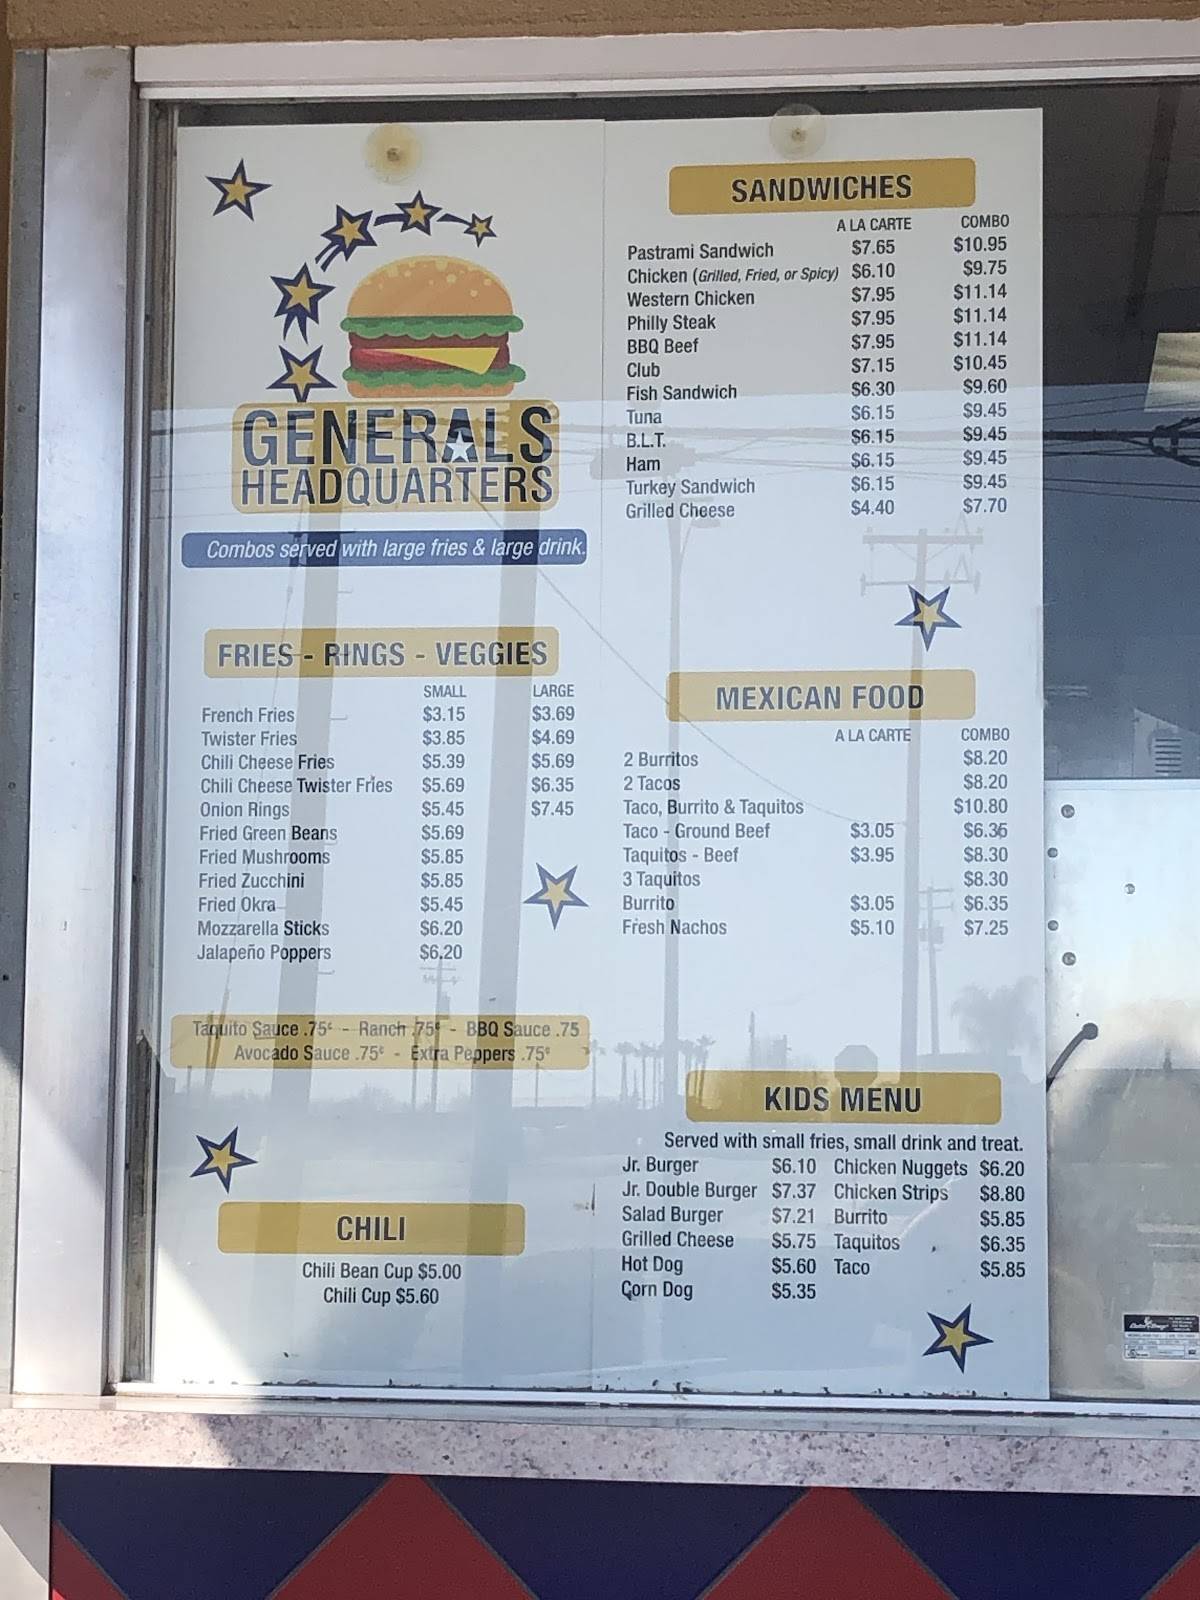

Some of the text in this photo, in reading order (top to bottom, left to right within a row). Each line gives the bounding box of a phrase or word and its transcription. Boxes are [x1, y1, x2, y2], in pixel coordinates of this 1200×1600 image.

[732, 174, 912, 203] SANDWICHES
[836, 214, 1010, 231] A LA CARTE COMBO
[627, 236, 1007, 260] Pastrami Sandwich $7.65 $10.95
[627, 260, 1007, 284] Chicken (Grilled, Fried, or Spicy) $6.10 $9.75
[627, 284, 1007, 307] Western Chicken $7.95 $11.14
[627, 355, 1007, 378] Club $7.15 $10.45
[627, 379, 1007, 401] Fish Sandwich $6.30 $9.60
[243, 405, 553, 466] GENERALS
[627, 426, 1007, 448] B.L.T. $6.15 $9.45
[241, 466, 553, 506] HEADQUARTERS
[626, 498, 1007, 519] Grilled Cheese $4.40 $7.70
[207, 537, 587, 560] Combos served with large fries & large drink.
[218, 643, 294, 668] FRIES
[324, 642, 405, 666] RINGS
[436, 641, 548, 665] VEGGIES
[424, 684, 575, 698] SMALL LARGE
[716, 685, 925, 710] MEXICAN FOOD
[202, 706, 575, 723] French Fries $3.15 $3.69
[835, 727, 1010, 742] A LA CARTE COMBO
[201, 753, 575, 771] Chili Cheese Fries $5.39 $5.69
[623, 749, 1008, 768] 2 Burritos $8.20
[201, 775, 574, 794] Chili Cheese Twister Fries $5.69 $6.35
[623, 798, 1008, 818] Taco, Burrito & Taquitos $10.80
[199, 848, 464, 865] Fried Mushrooms $5.85
[623, 847, 687, 866] Taquitos
[704, 847, 739, 863] Beef
[850, 846, 895, 863] $3.95
[963, 846, 1009, 863] $8.30
[198, 896, 463, 913] Fried Okra $5.45
[197, 920, 463, 937] Mozzarella Sticks $6.20
[622, 919, 1009, 936] Fresh Nachos $5.10 $7.25
[197, 944, 463, 964] Jalapeño Poppers $6.20
[192, 1021, 248, 1041] Taquito
[252, 1021, 299, 1037] Sauce
[359, 1020, 407, 1037] Ranch
[466, 1020, 500, 1038] BBQ
[504, 1021, 551, 1038] Sauce
[234, 1045, 300, 1061] Avocado
[303, 1045, 350, 1061] Sauce
[410, 1045, 450, 1061] Extra
[454, 1045, 516, 1064] Peppers
[765, 1087, 922, 1113] KIDS MENU
[664, 1132, 1024, 1153] Served with small fries, small drink and treat.
[622, 1157, 1025, 1179] Jr. Burger $6.10 Chicken Nuggets $6.20
[622, 1182, 1026, 1204] Jr. Double Burger $7.37 Chicken Strips $8.80
[336, 1216, 407, 1242] CHILI
[302, 1262, 462, 1282] Chili Bean Cup $5.00
[323, 1287, 440, 1307] Chili Cup $5.60
[621, 1281, 817, 1301] Corn Dog $5.35
